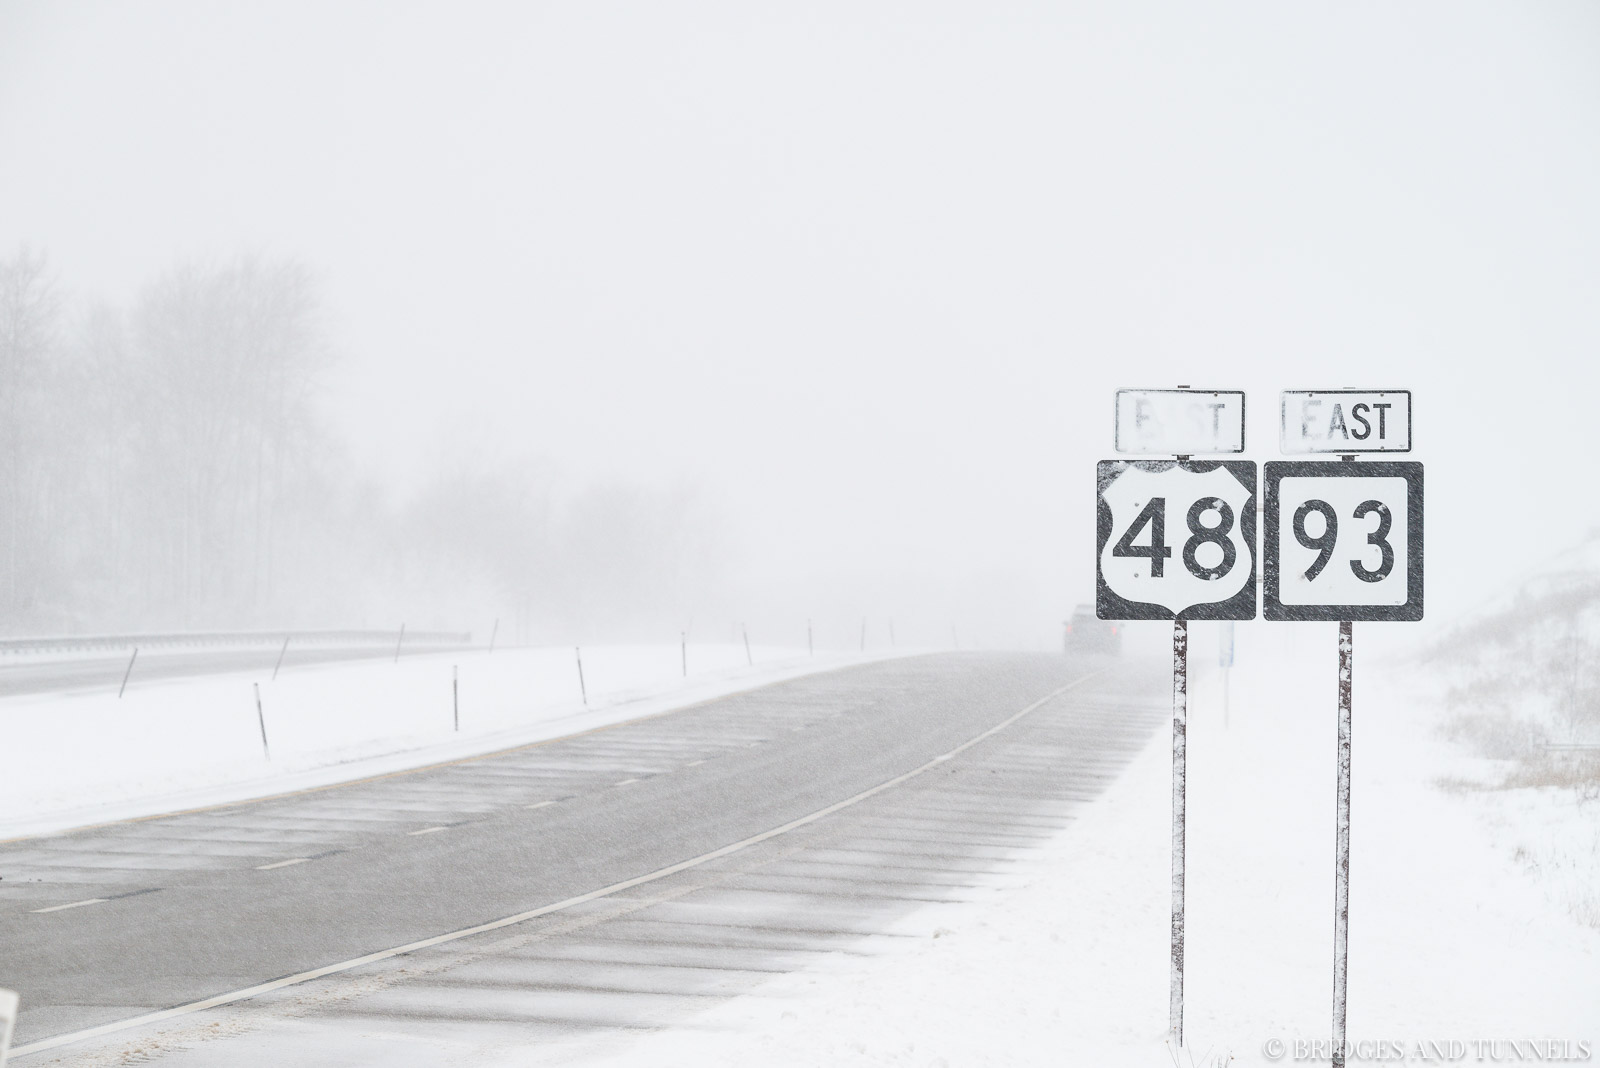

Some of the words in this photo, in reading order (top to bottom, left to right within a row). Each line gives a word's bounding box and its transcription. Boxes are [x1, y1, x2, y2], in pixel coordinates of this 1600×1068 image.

[1301, 400, 1392, 440] EAST
[1112, 496, 1237, 581] 48
[1292, 499, 1395, 583] 93
